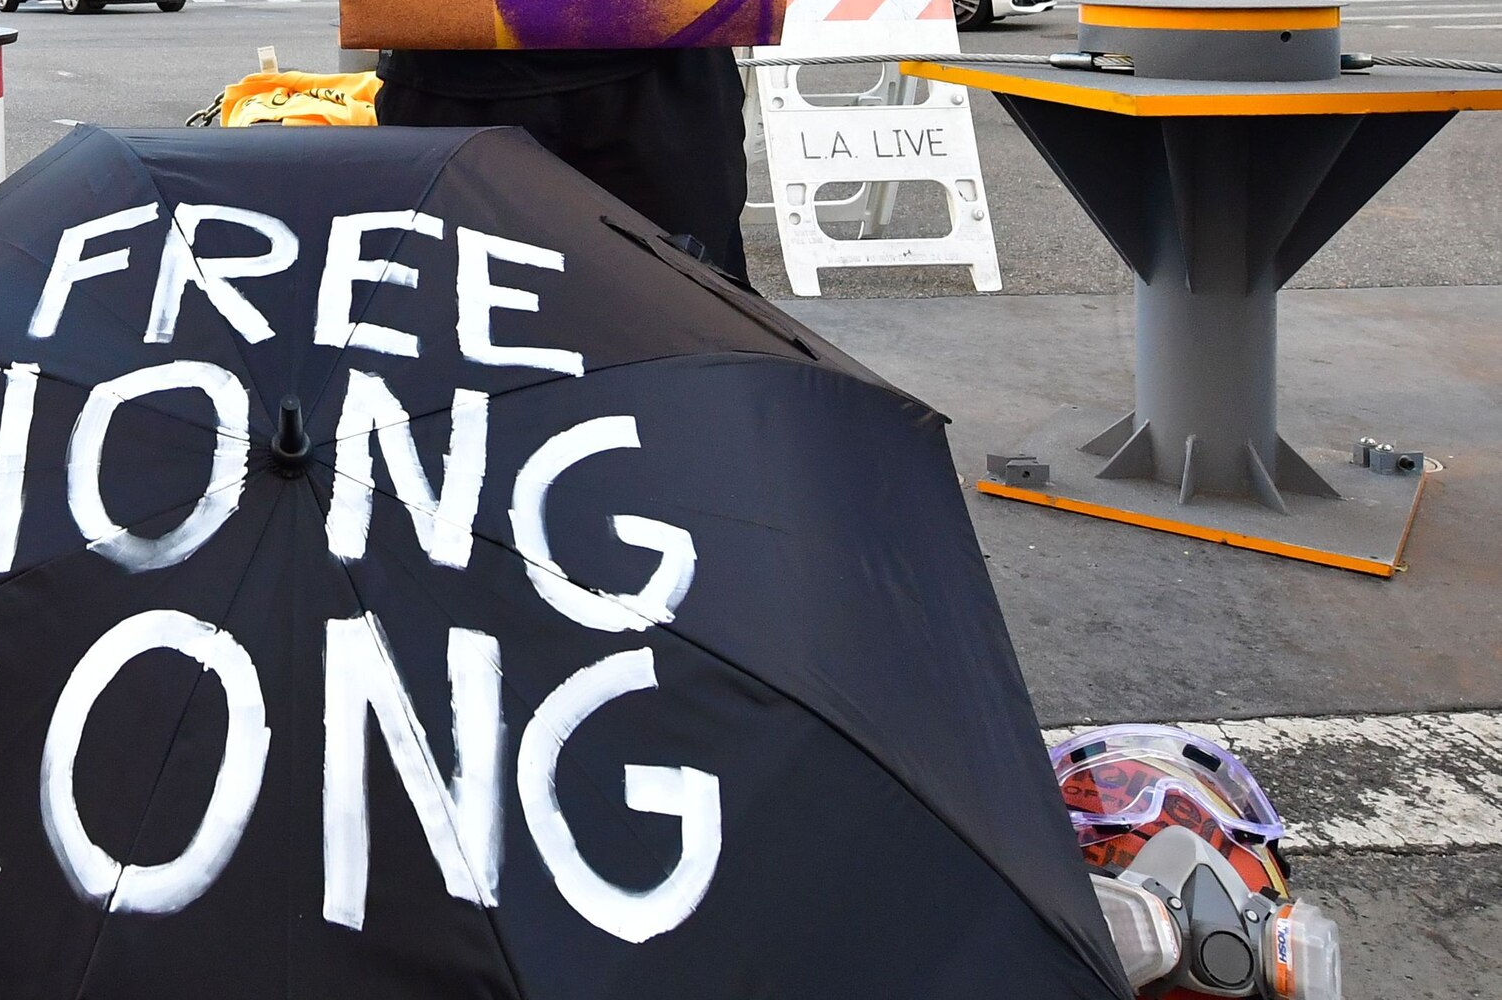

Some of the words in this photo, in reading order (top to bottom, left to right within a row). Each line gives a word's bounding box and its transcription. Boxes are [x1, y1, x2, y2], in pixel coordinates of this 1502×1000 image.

[800, 130, 859, 159] L.A.
[872, 128, 948, 158] LIVE
[28, 202, 584, 377] FREE
